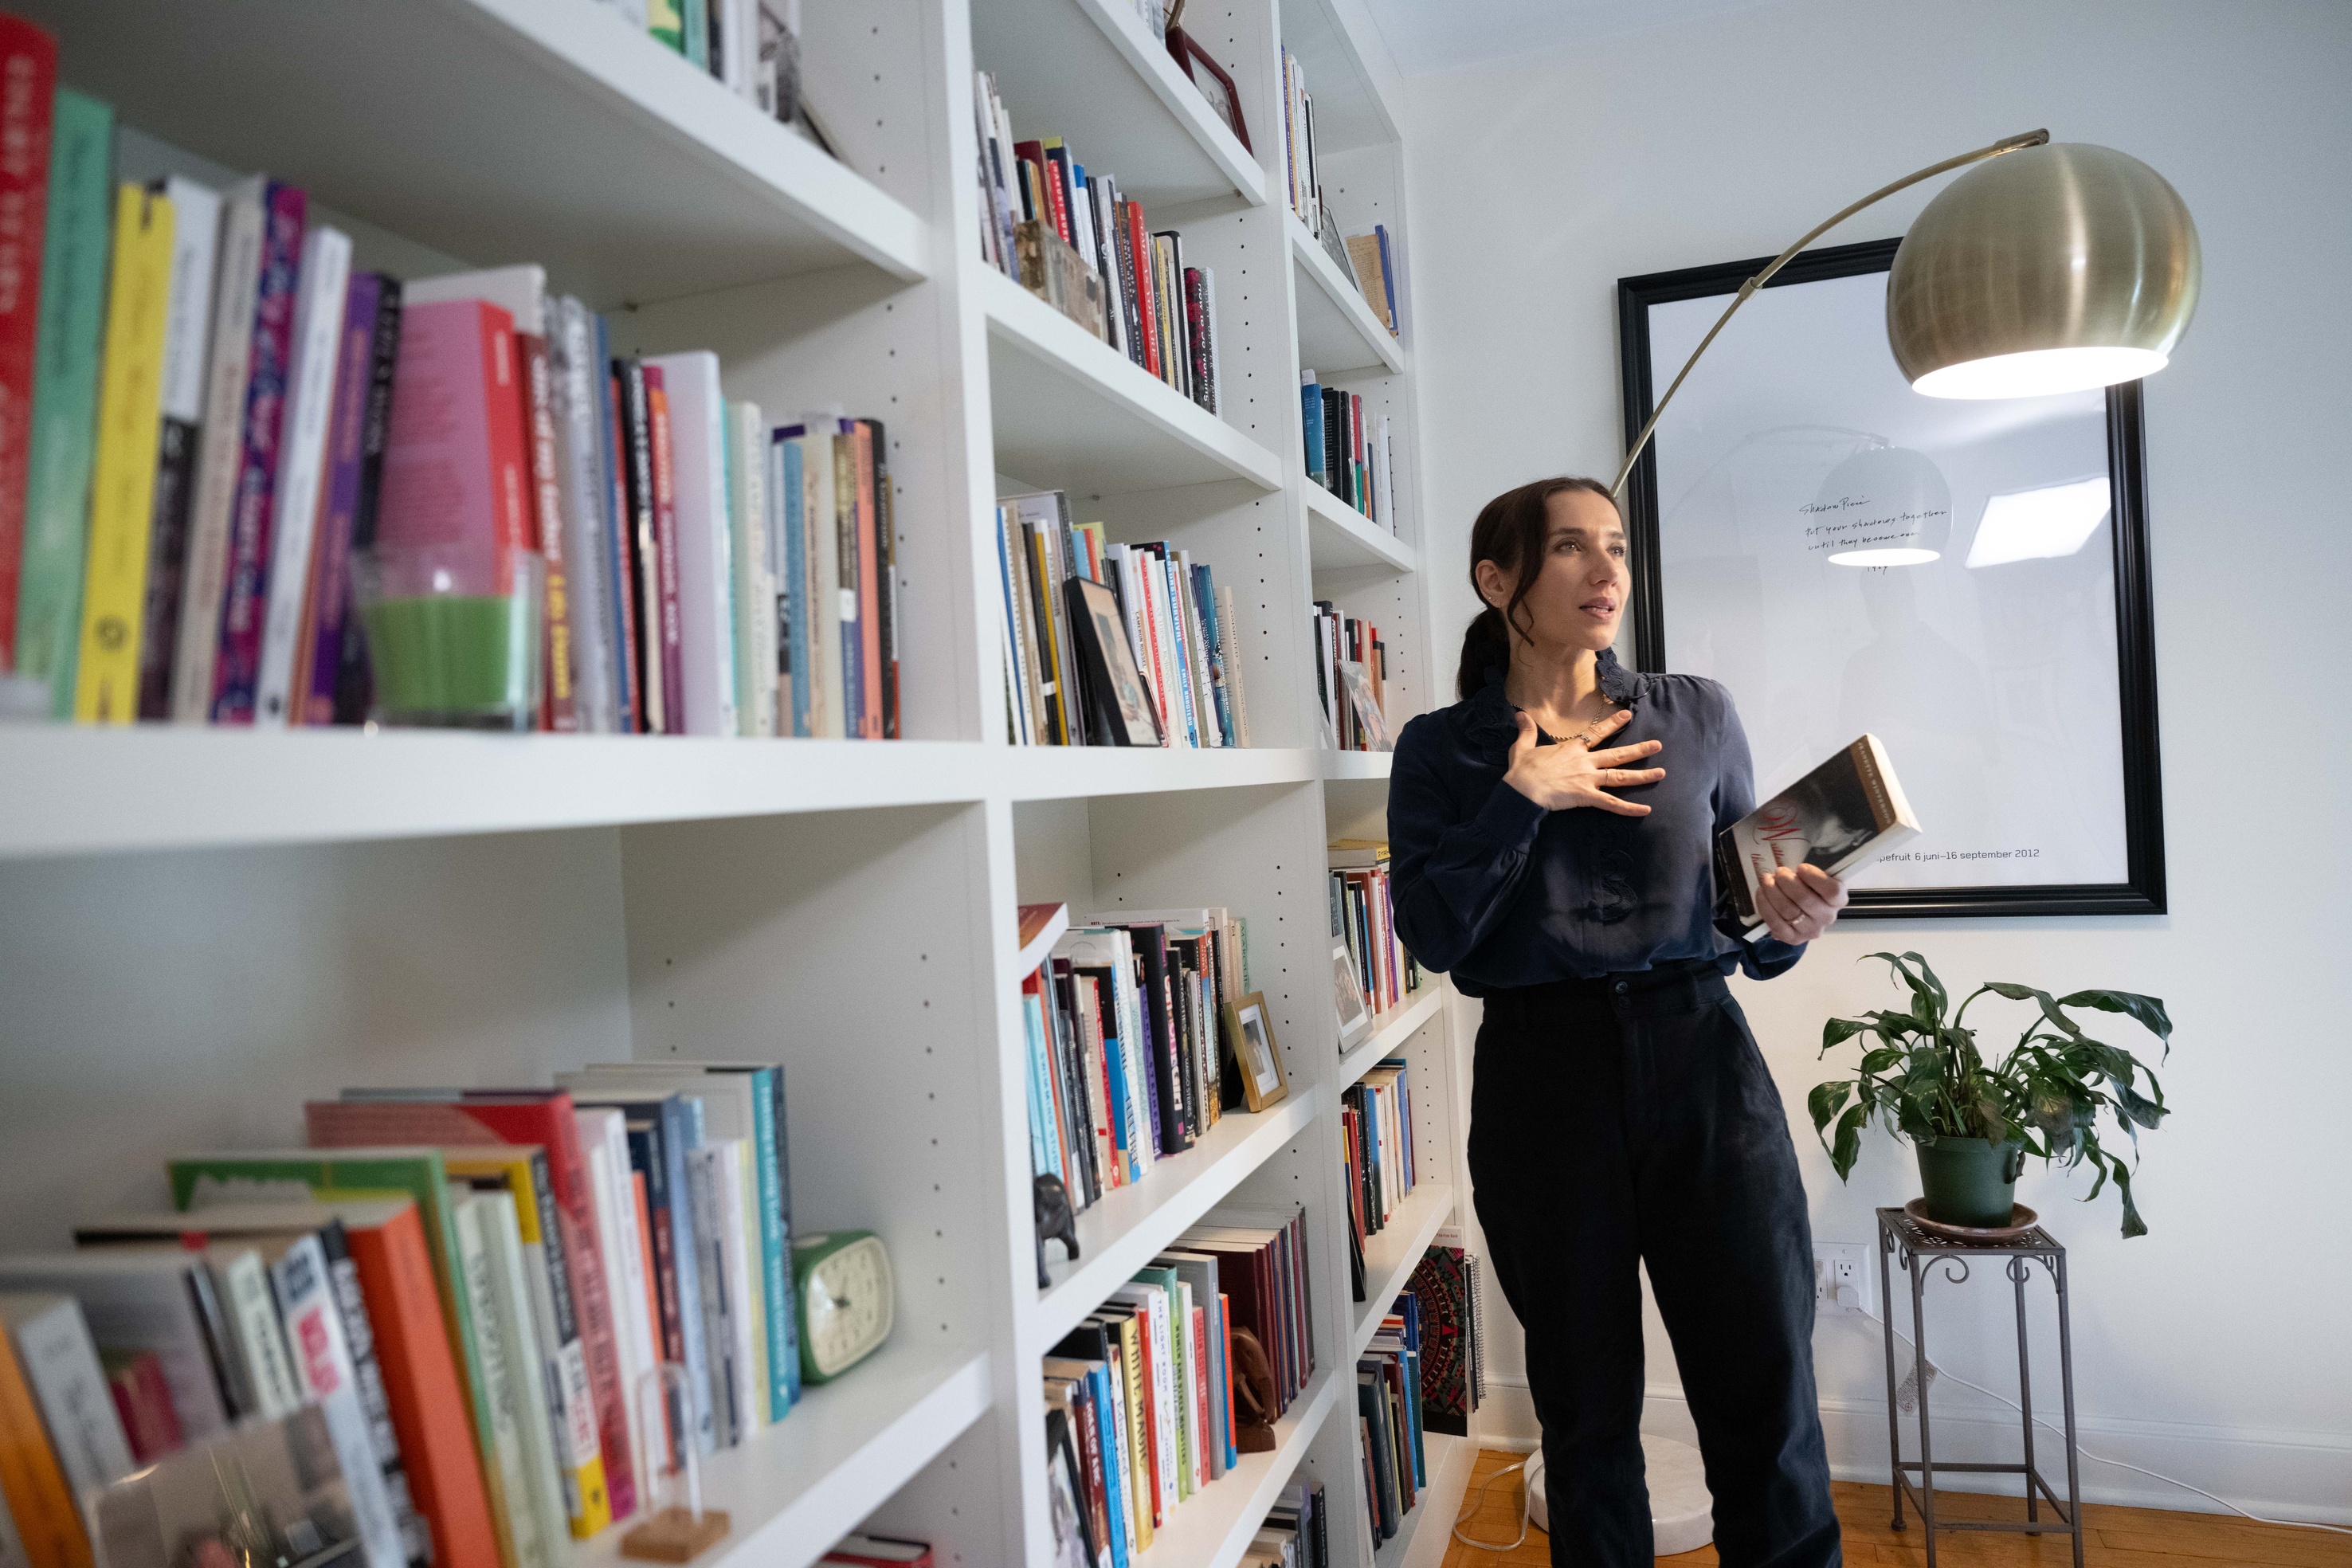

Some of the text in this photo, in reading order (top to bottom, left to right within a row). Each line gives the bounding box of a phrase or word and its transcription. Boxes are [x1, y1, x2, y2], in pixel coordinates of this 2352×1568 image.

[1053, 166, 1070, 243] HARUKI MURA
[1120, 279, 1131, 317] Refugee
[1144, 269, 1149, 284] AS
[1201, 315, 1205, 327] to
[1201, 331, 1206, 349] Do
[1200, 353, 1210, 402] Nothing
[1808, 540, 1834, 551] until
[1839, 538, 1858, 547] they
[1826, 525, 1847, 535] your
[1852, 517, 1895, 529] shadows
[1900, 510, 1947, 525] together
[1172, 597, 1182, 644] SURVIVAL
[1229, 604, 1239, 658] COMMITTED
[1163, 651, 1172, 692] ROBINSON
[1183, 690, 1194, 727] RABOTEAU
[1877, 853, 1911, 863] pefruit
[1960, 850, 2013, 860] september
[2014, 849, 2040, 858] 2012
[1131, 1005, 1143, 1054] VANESSA
[1039, 1051, 1055, 1125] SWIMMING
[1130, 1329, 1147, 1467] WHITE MAGIC
[1116, 1400, 1129, 1476] Educated
[1381, 1447, 1395, 1494] CHING
